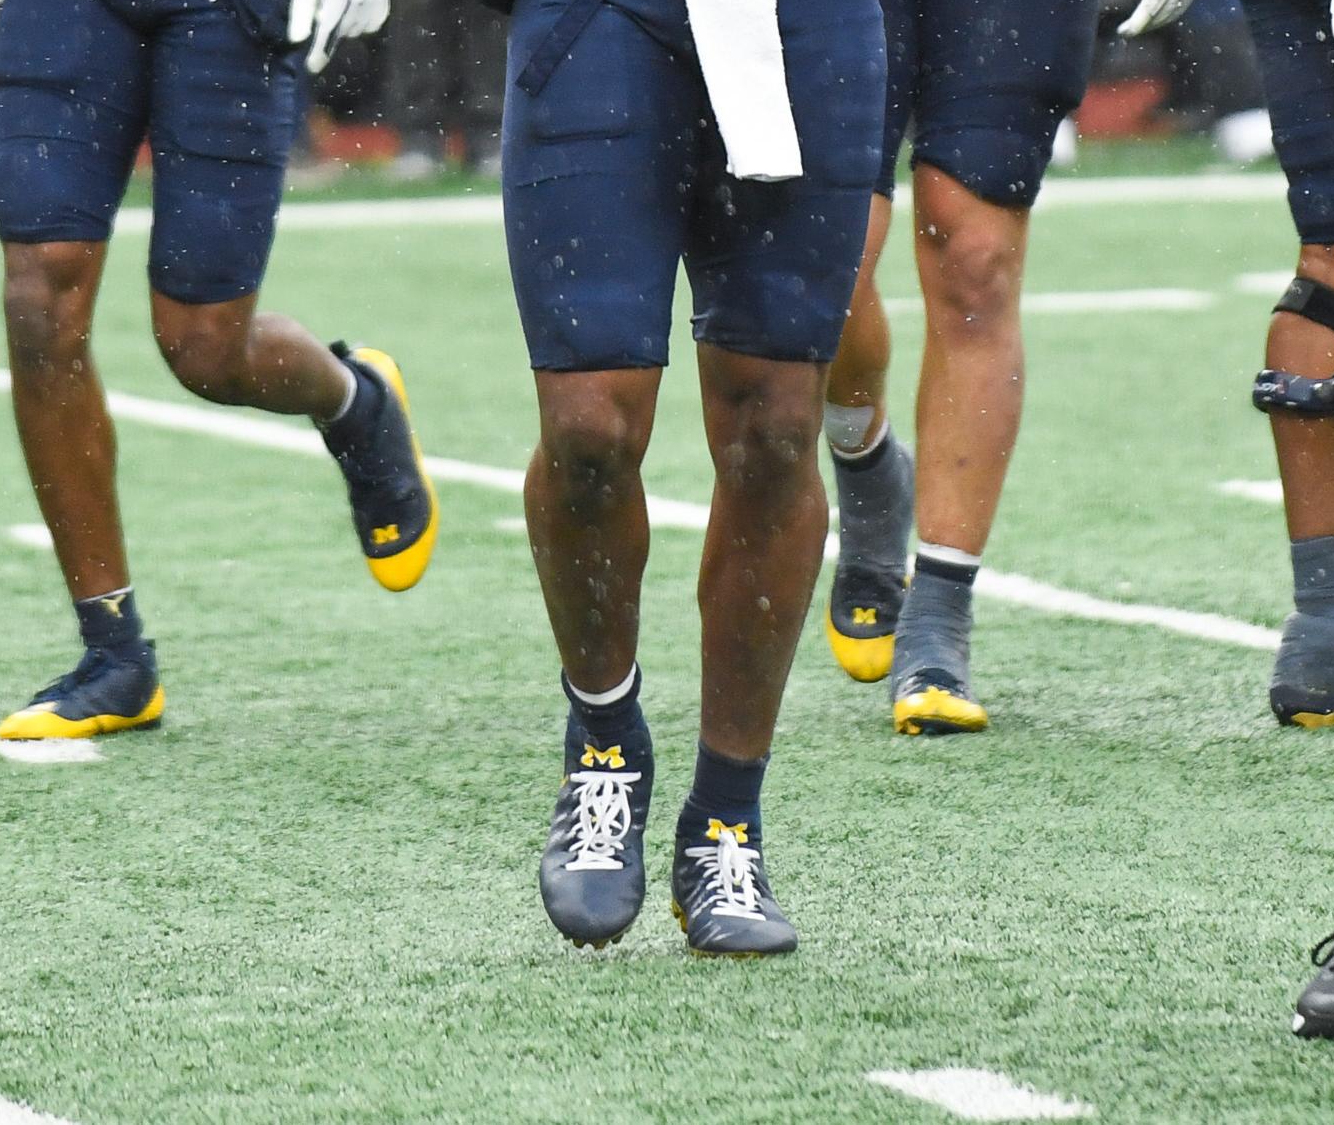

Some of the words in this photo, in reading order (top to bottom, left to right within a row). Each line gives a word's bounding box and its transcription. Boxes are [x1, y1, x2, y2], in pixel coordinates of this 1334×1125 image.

[372, 523, 400, 546] M
[853, 607, 876, 625] M
[580, 744, 626, 769] M
